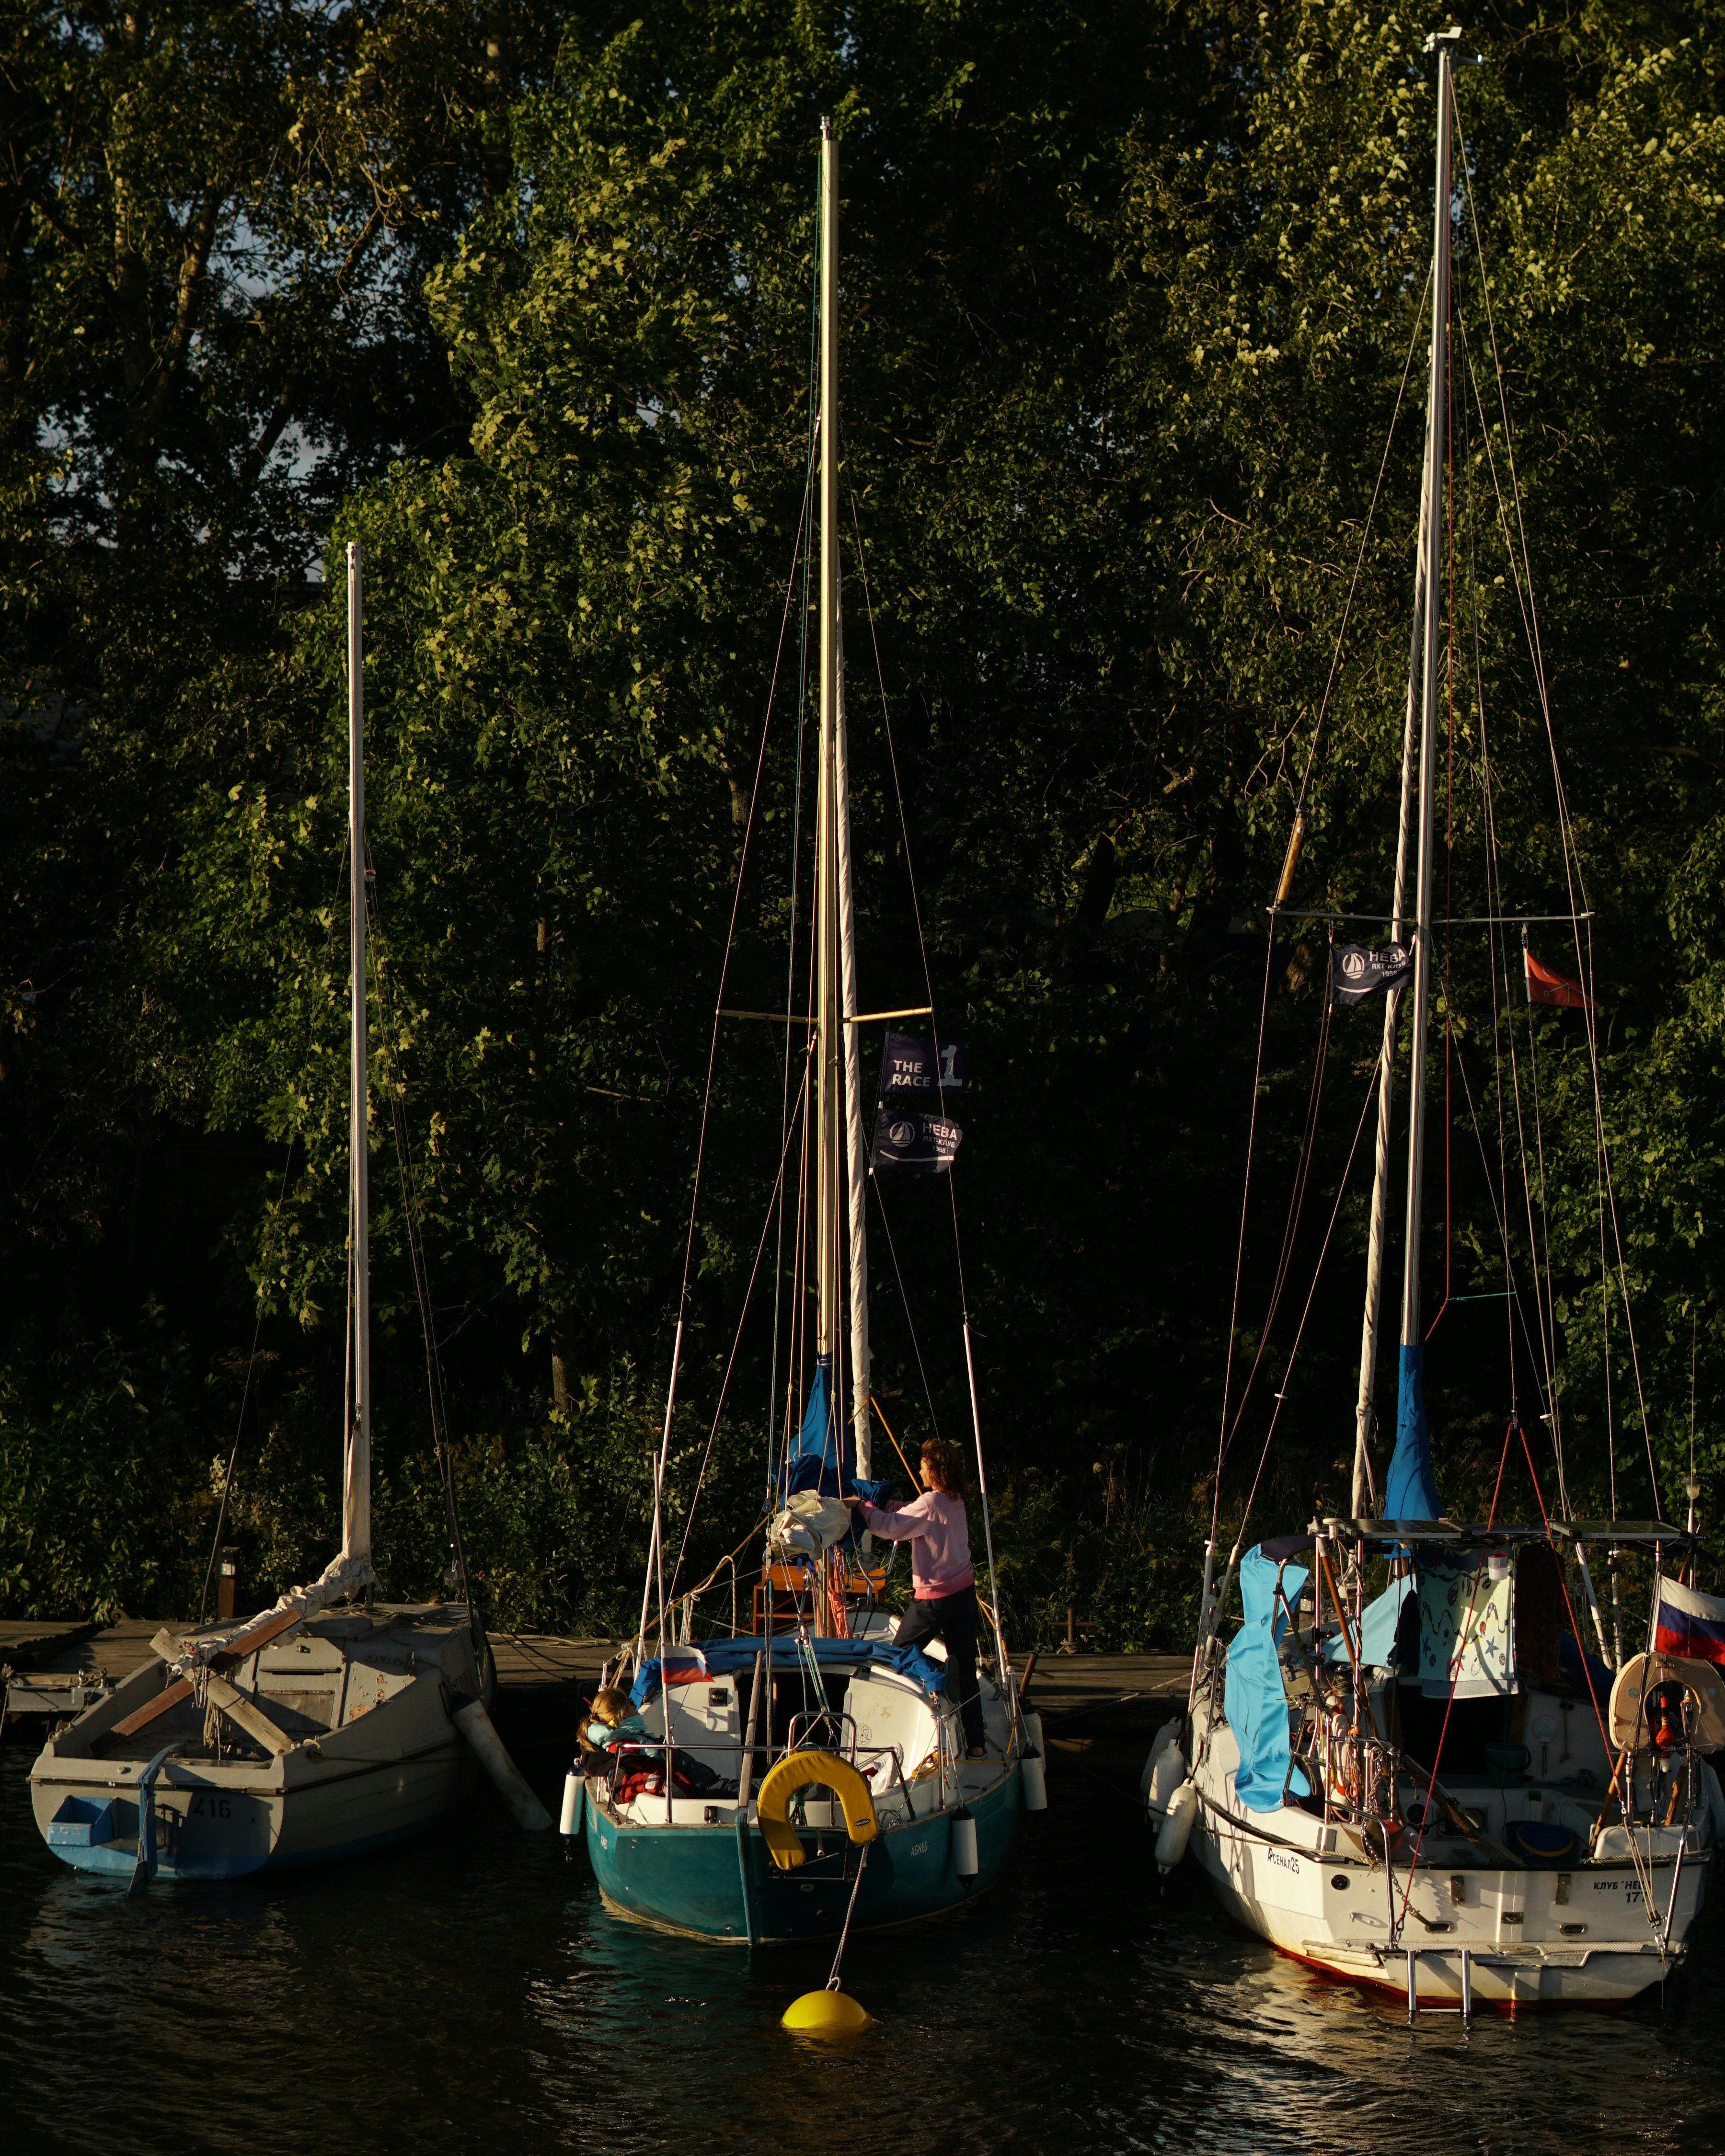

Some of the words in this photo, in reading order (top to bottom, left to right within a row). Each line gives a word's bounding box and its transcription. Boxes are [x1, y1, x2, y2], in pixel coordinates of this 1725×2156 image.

[1369, 949, 1405, 963] НЕВА
[1372, 960, 1406, 970] ЯХТ-КЛУБ
[894, 1060, 922, 1073] THE
[937, 1045, 962, 1086] 1
[892, 1074, 931, 1087] RACE
[922, 1122, 957, 1140] НЕВА
[923, 1136, 955, 1147] ЯХТ-КЛУБ
[932, 1146, 946, 1154] 1958
[193, 1798, 230, 1818] 416
[910, 1841, 927, 1857] AGNES
[1625, 1892, 1647, 1903] 177
